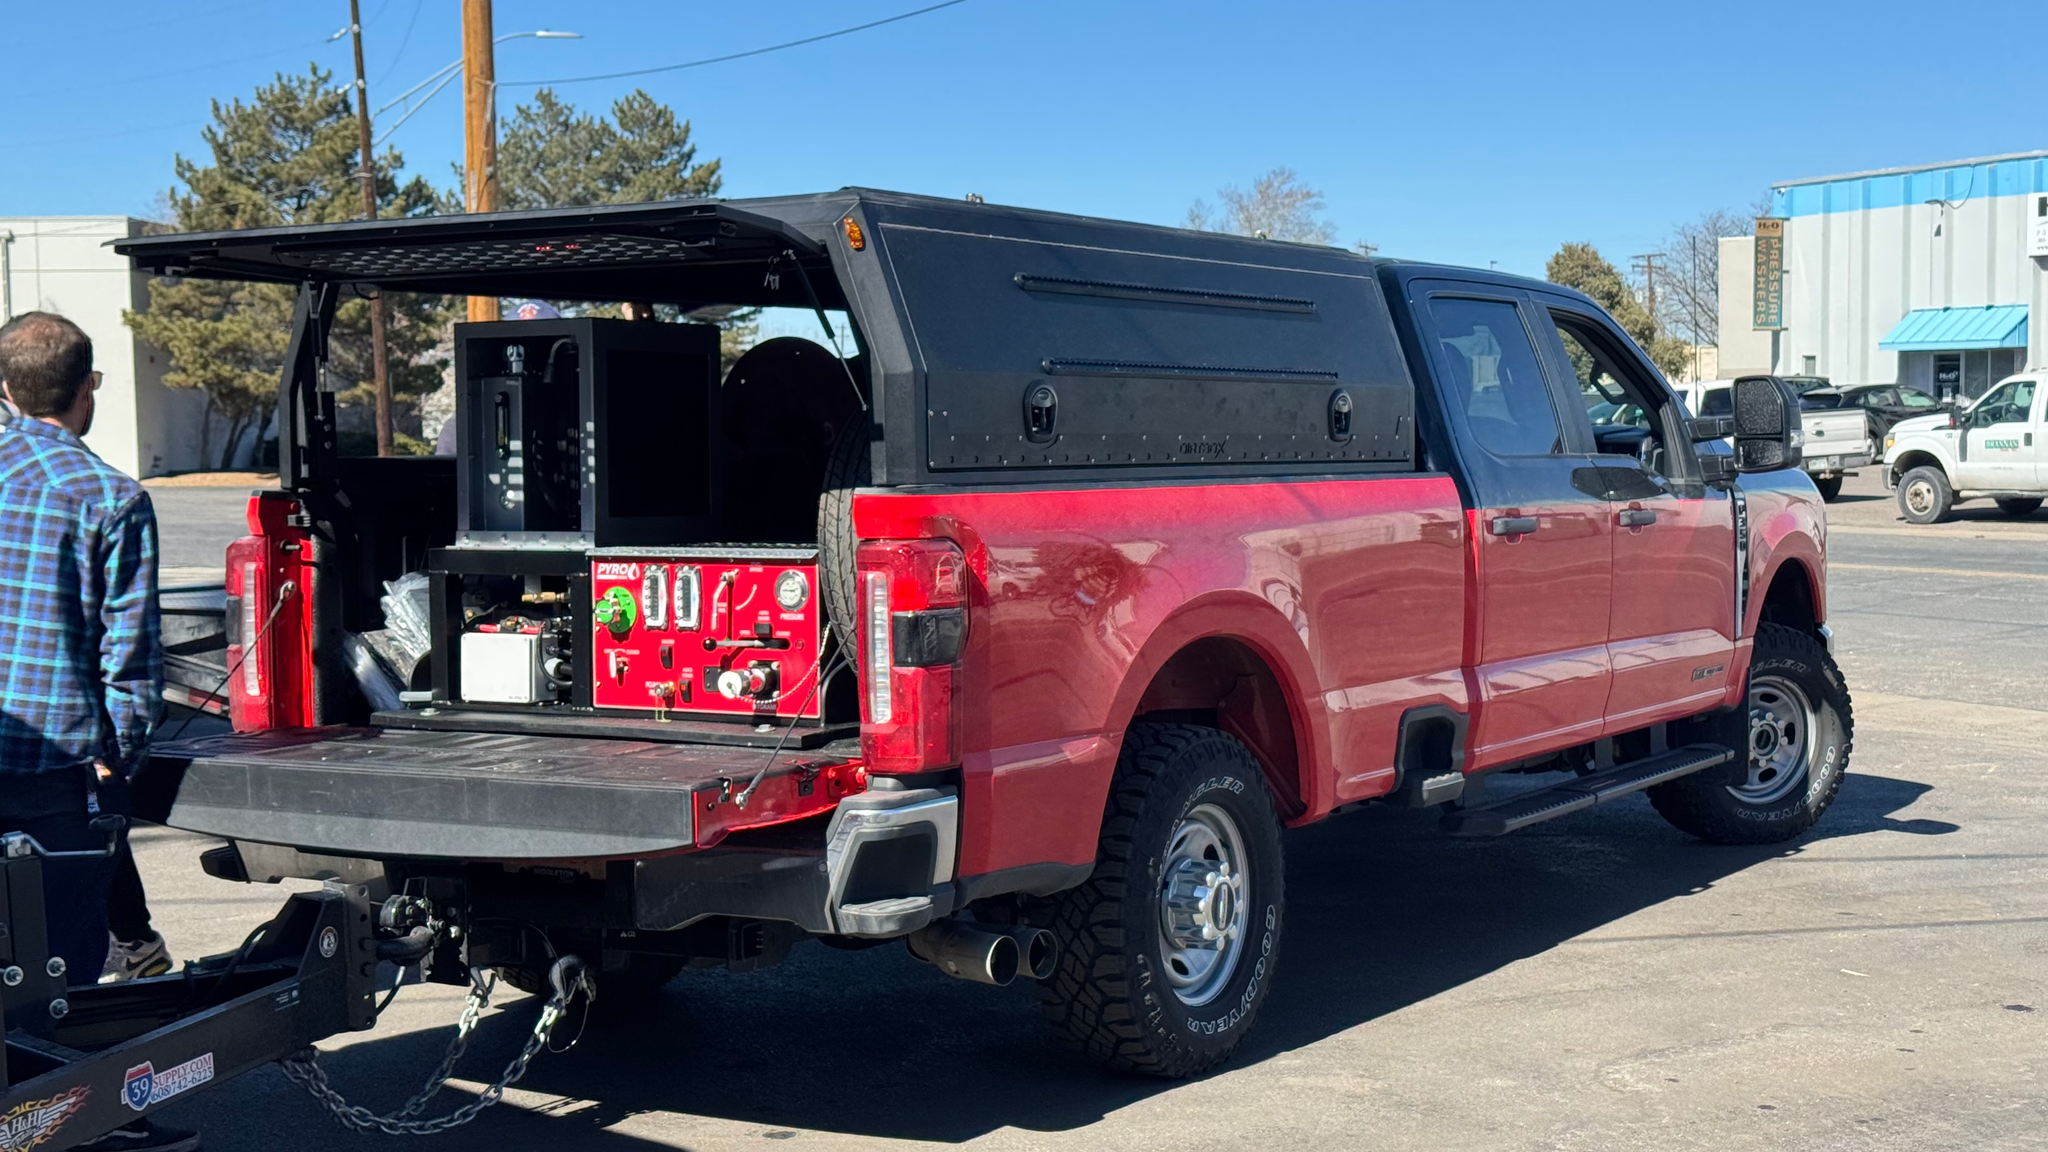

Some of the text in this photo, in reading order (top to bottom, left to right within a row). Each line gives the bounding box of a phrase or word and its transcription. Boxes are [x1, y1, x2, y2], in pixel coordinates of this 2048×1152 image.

[1756, 239, 1767, 324] WASHERS
[1768, 238, 1779, 323] PRESSURE
[597, 563, 629, 575] PYRO
[1737, 746, 1836, 821] GOODYEAR
[1187, 905, 1276, 1035] GOODYEAR
[132, 1077, 149, 1101] 39
[152, 1054, 212, 1089] SUPPLY.COM
